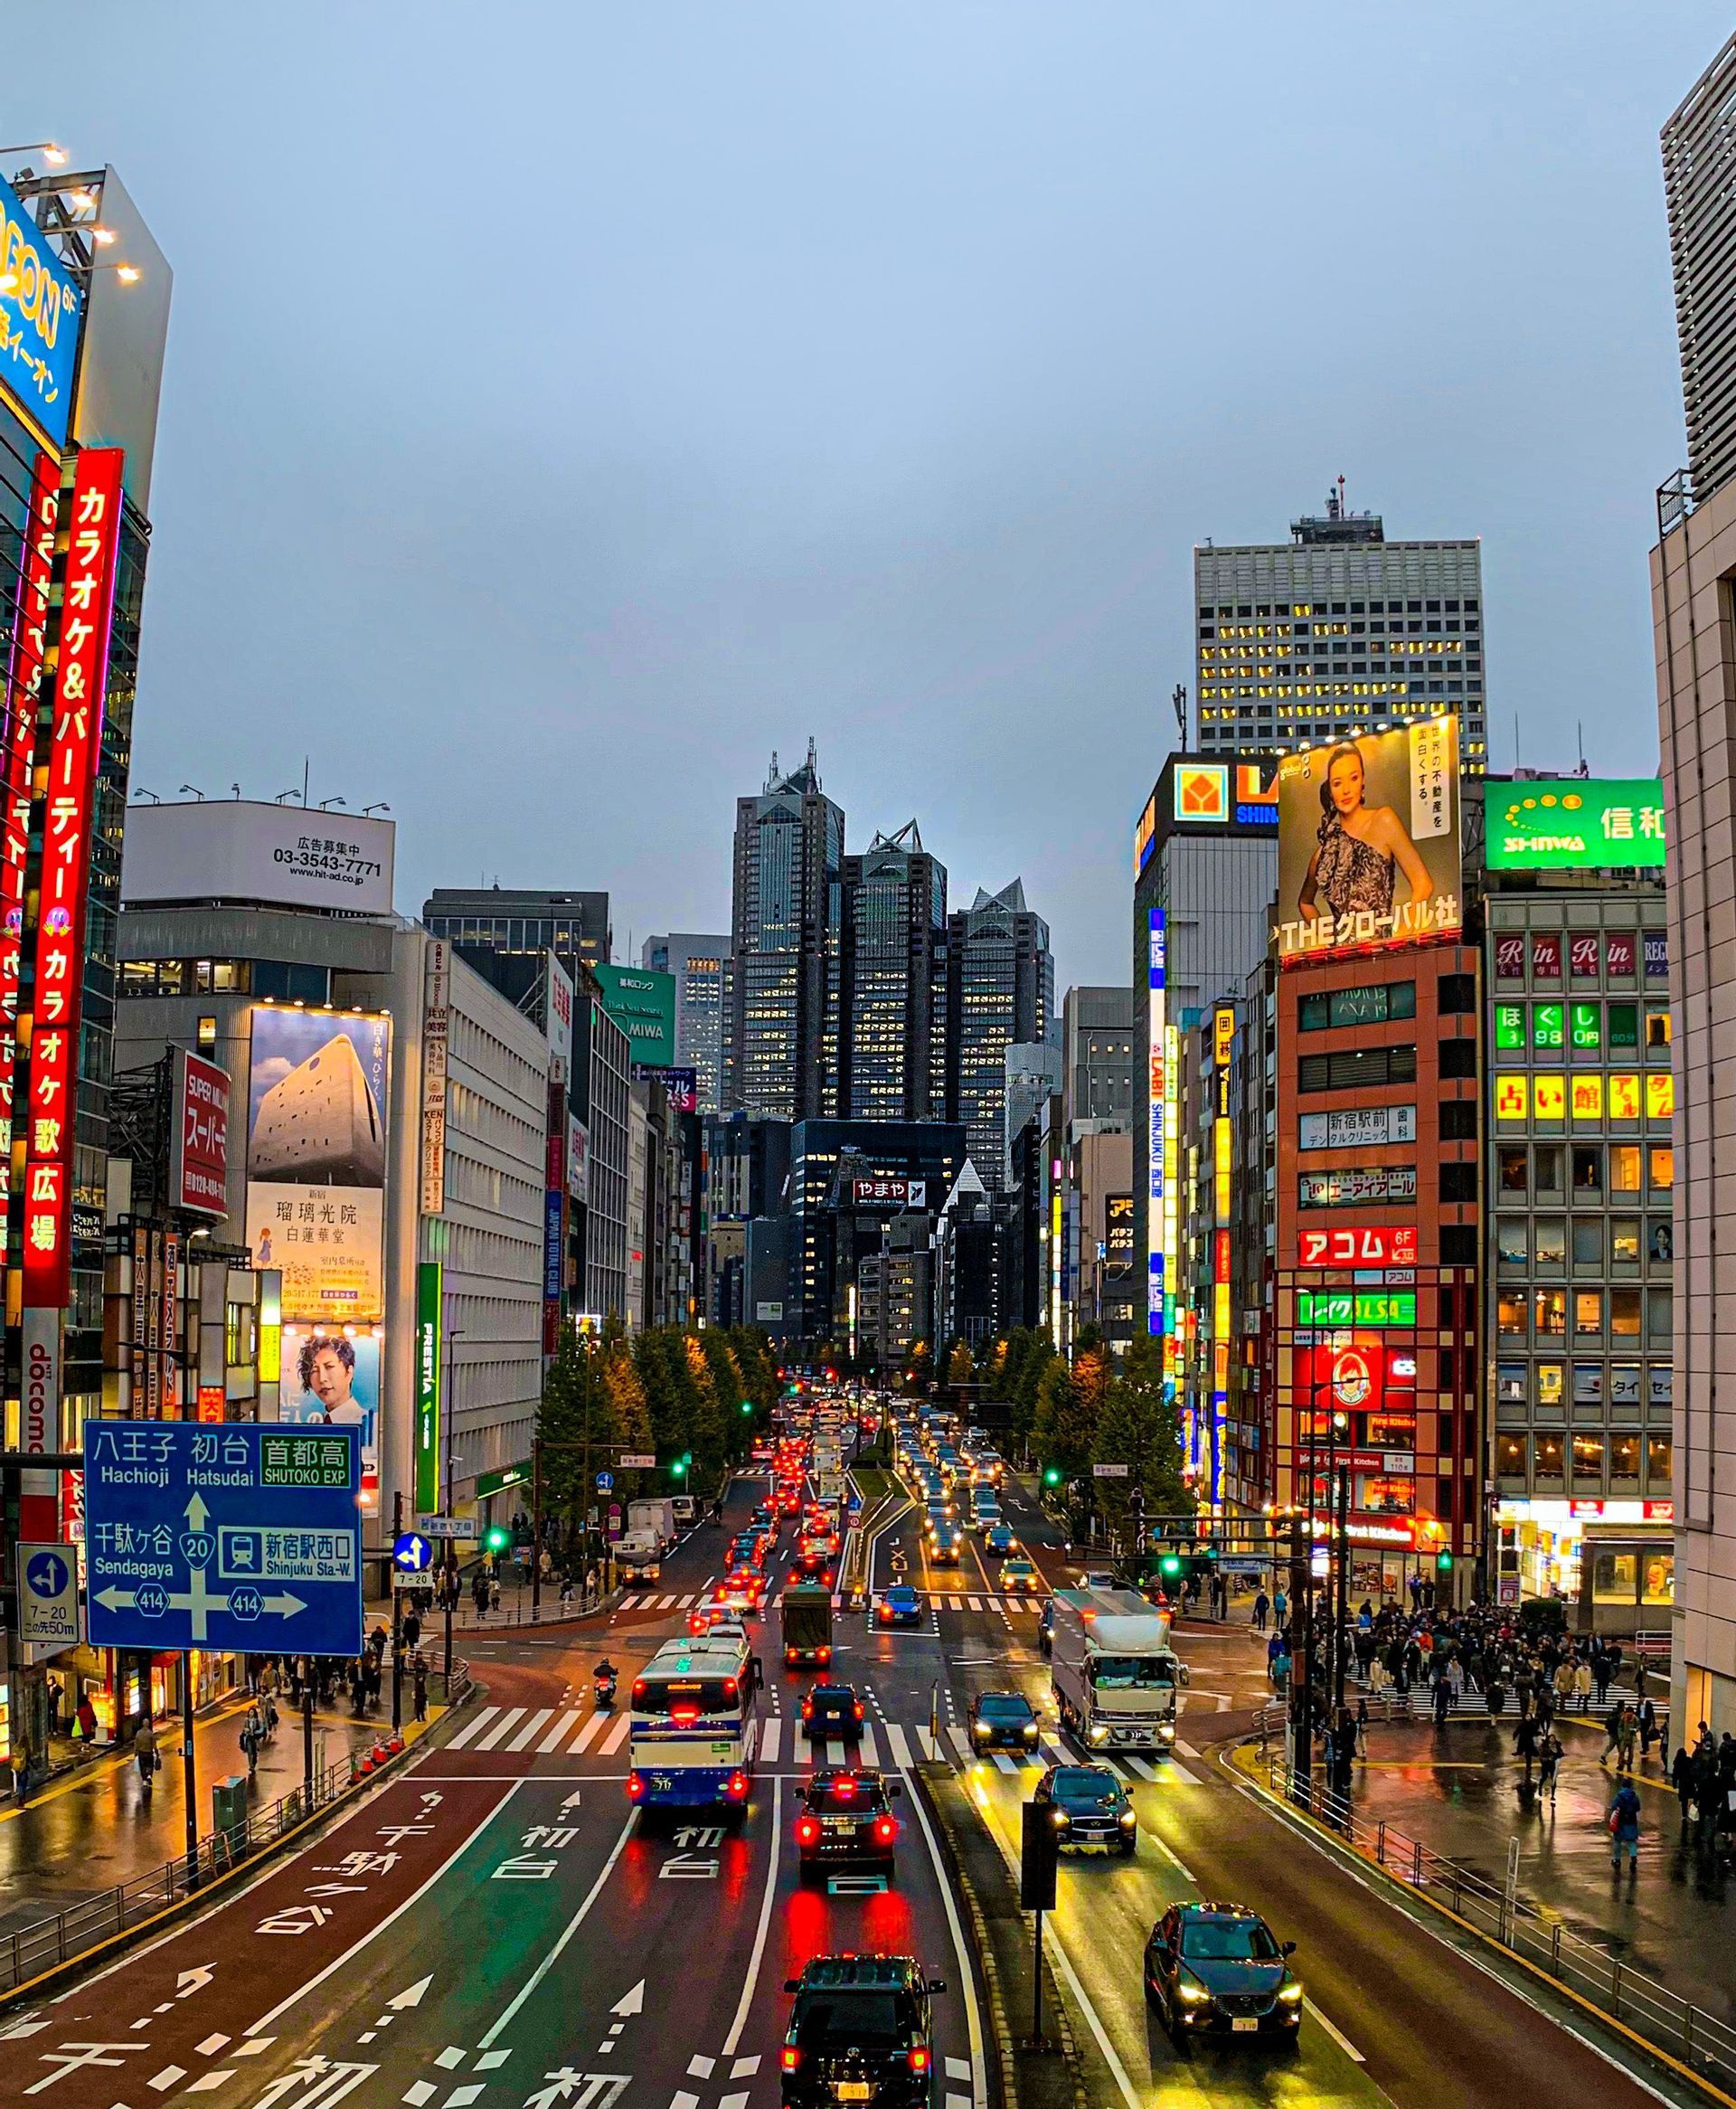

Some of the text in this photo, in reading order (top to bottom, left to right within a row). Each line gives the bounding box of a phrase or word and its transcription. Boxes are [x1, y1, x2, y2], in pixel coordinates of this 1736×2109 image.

[0, 200, 61, 349] EON
[297, 837, 361, 857] 広告募集中
[274, 848, 382, 877] 03-3543-7771
[289, 866, 364, 886] www.hit-ad.co.jp
[1502, 1007, 1594, 1026] ほぐし
[628, 1023, 665, 1039] MIWA
[1151, 1056, 1164, 1096] LABI
[30, 949, 67, 1253] カラオケ歌広場
[1499, 1084, 1599, 1112] 占い館
[425, 1110, 443, 1119] KEN
[1330, 1111, 1386, 1130] 新宿駅前
[1397, 1109, 1408, 1140] 歯科
[1151, 1103, 1163, 1163] SHINJUKU
[858, 1182, 905, 1197] やまや
[277, 1201, 357, 1225] 瑠璃光院
[287, 1225, 344, 1244] 白蓮華堂
[1395, 1231, 1411, 1245] 6F
[1306, 1230, 1383, 1262] アコム
[1389, 1272, 1412, 1281] アコム
[93, 1431, 345, 1467] 八王子 初台 首都高
[100, 1466, 345, 1488] Hachioji Hatsudai SHUTOKO EXP
[186, 1539, 208, 1557] 20
[266, 1534, 351, 1561] 新宿駅西口
[95, 1559, 352, 1579] Sendagaya Shinjuku Sta.-W.
[139, 1592, 258, 1612] 414 414
[25, 1621, 74, 1635] この先50m
